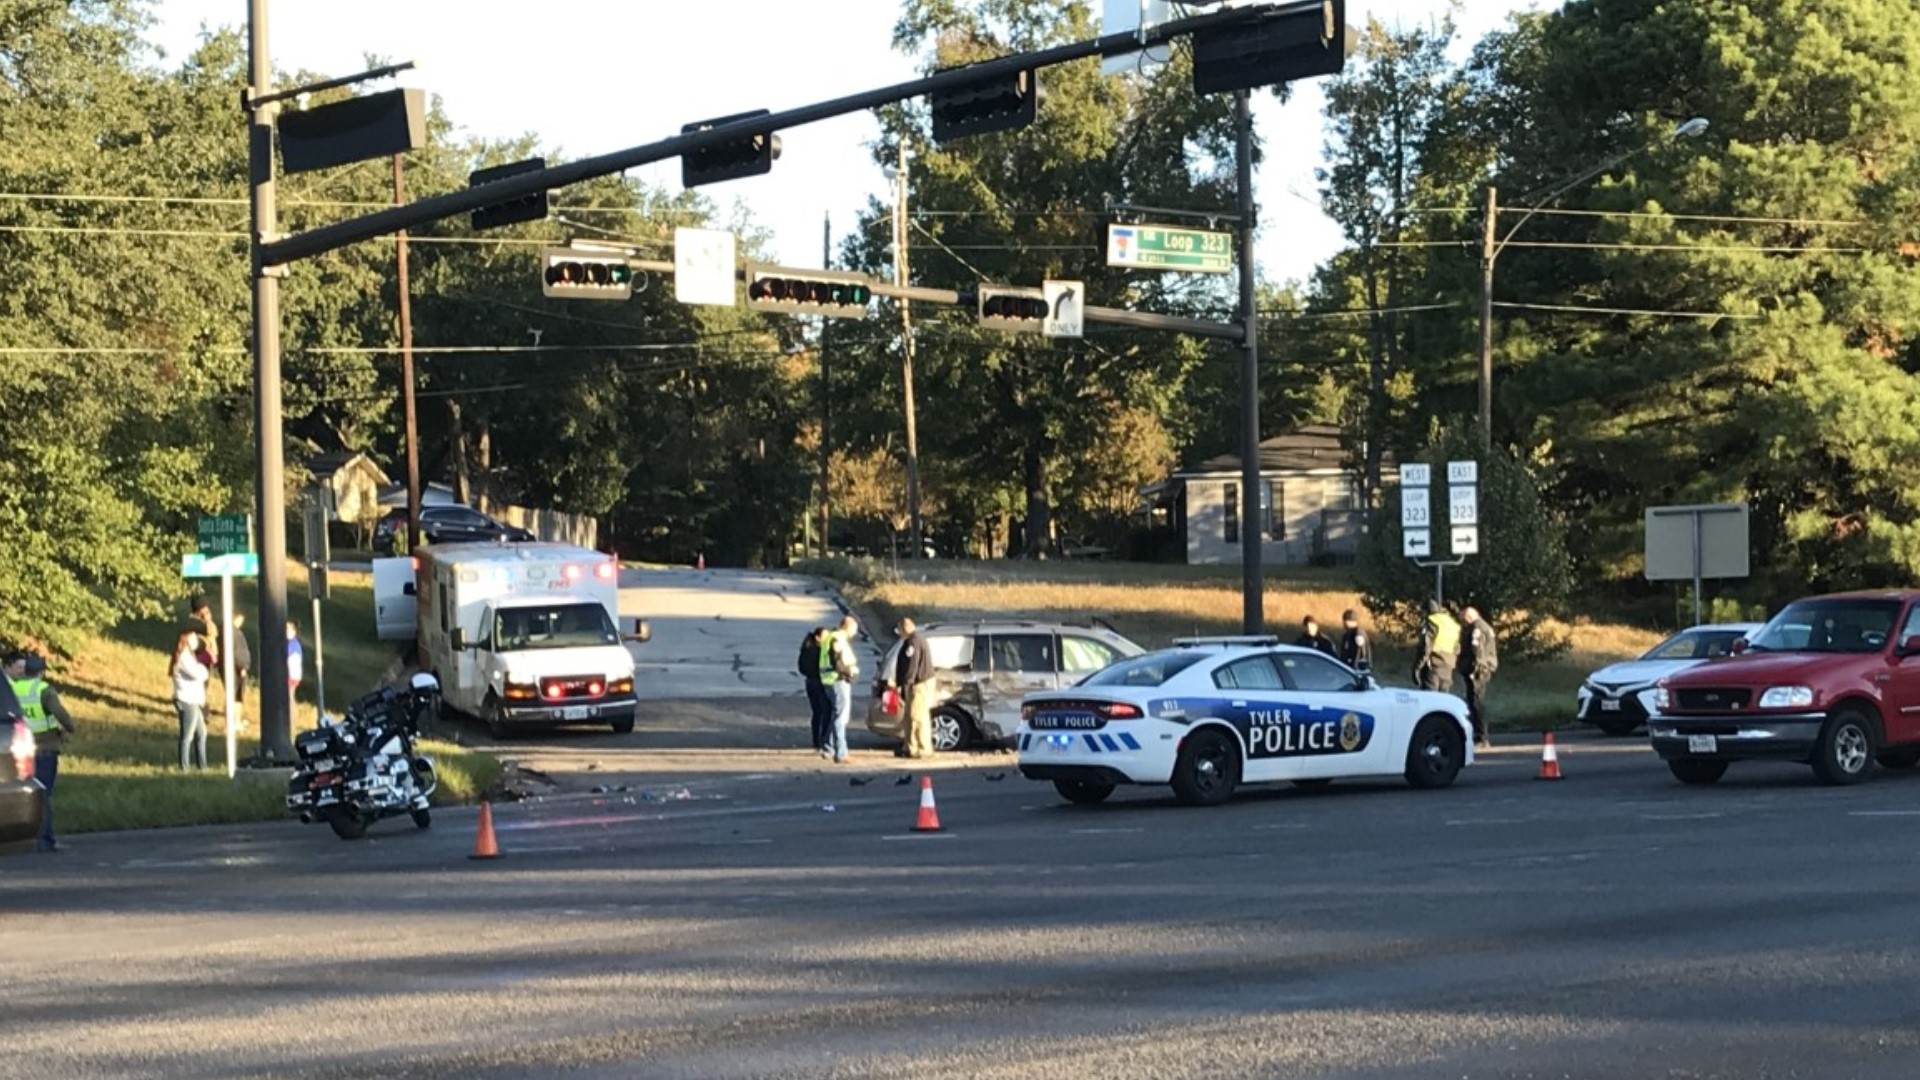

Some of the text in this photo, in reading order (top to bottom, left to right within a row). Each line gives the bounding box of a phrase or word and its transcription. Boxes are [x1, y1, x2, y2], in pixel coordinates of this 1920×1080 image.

[1164, 231, 1194, 252] Loop
[1201, 233, 1224, 251] 323
[1050, 323, 1078, 334] ONLY
[1405, 468, 1426, 481] WEST
[1451, 466, 1472, 479] EAST
[1406, 492, 1424, 501] LOOP
[1405, 507, 1426, 521] 323
[1453, 505, 1474, 519] 323
[1163, 700, 1178, 711] 911
[1034, 715, 1097, 727] TYLER POLICE
[1249, 709, 1292, 726] TYLER
[1249, 721, 1335, 754] POLICE
